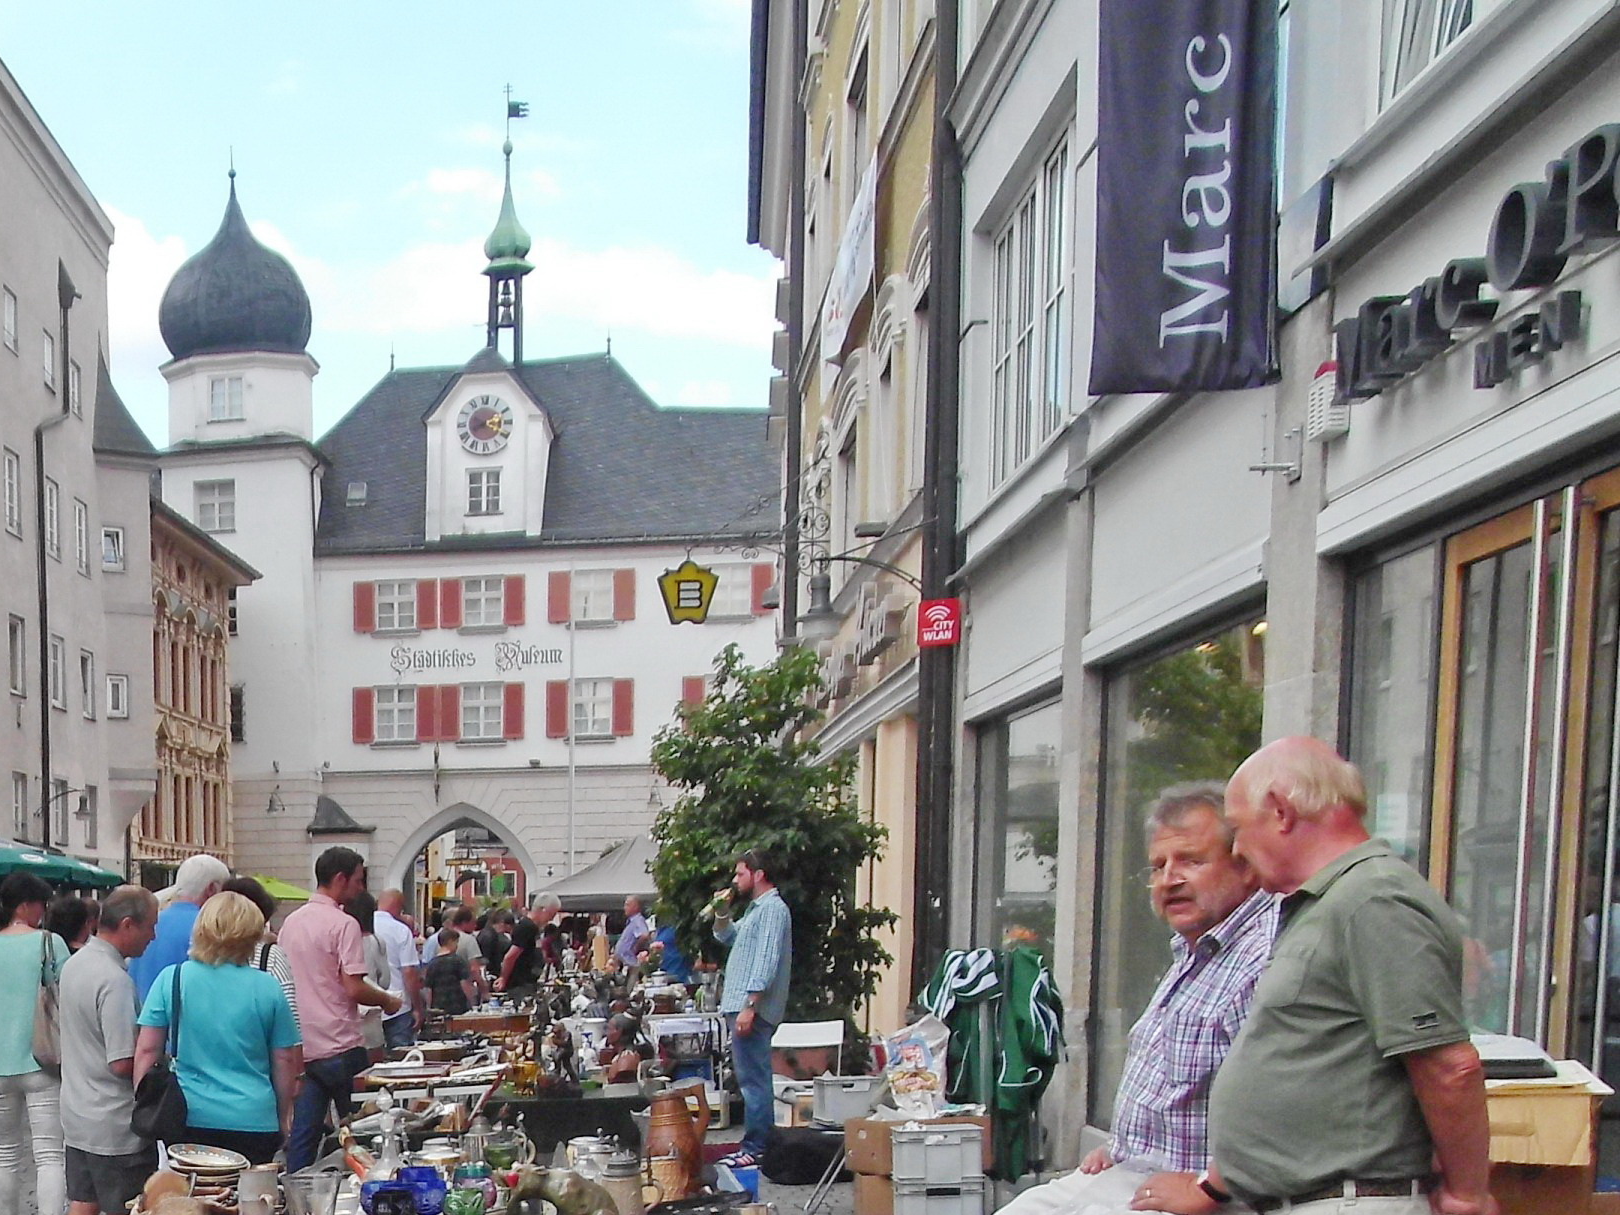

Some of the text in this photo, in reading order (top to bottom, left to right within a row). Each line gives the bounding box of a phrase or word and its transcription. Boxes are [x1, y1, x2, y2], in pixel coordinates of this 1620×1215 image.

[1160, 33, 1231, 348] Marc
[1332, 123, 1620, 404] Marc O'P
[1473, 290, 1581, 389] MEN
[923, 630, 953, 641] WLAN
[933, 620, 954, 631] CITY
